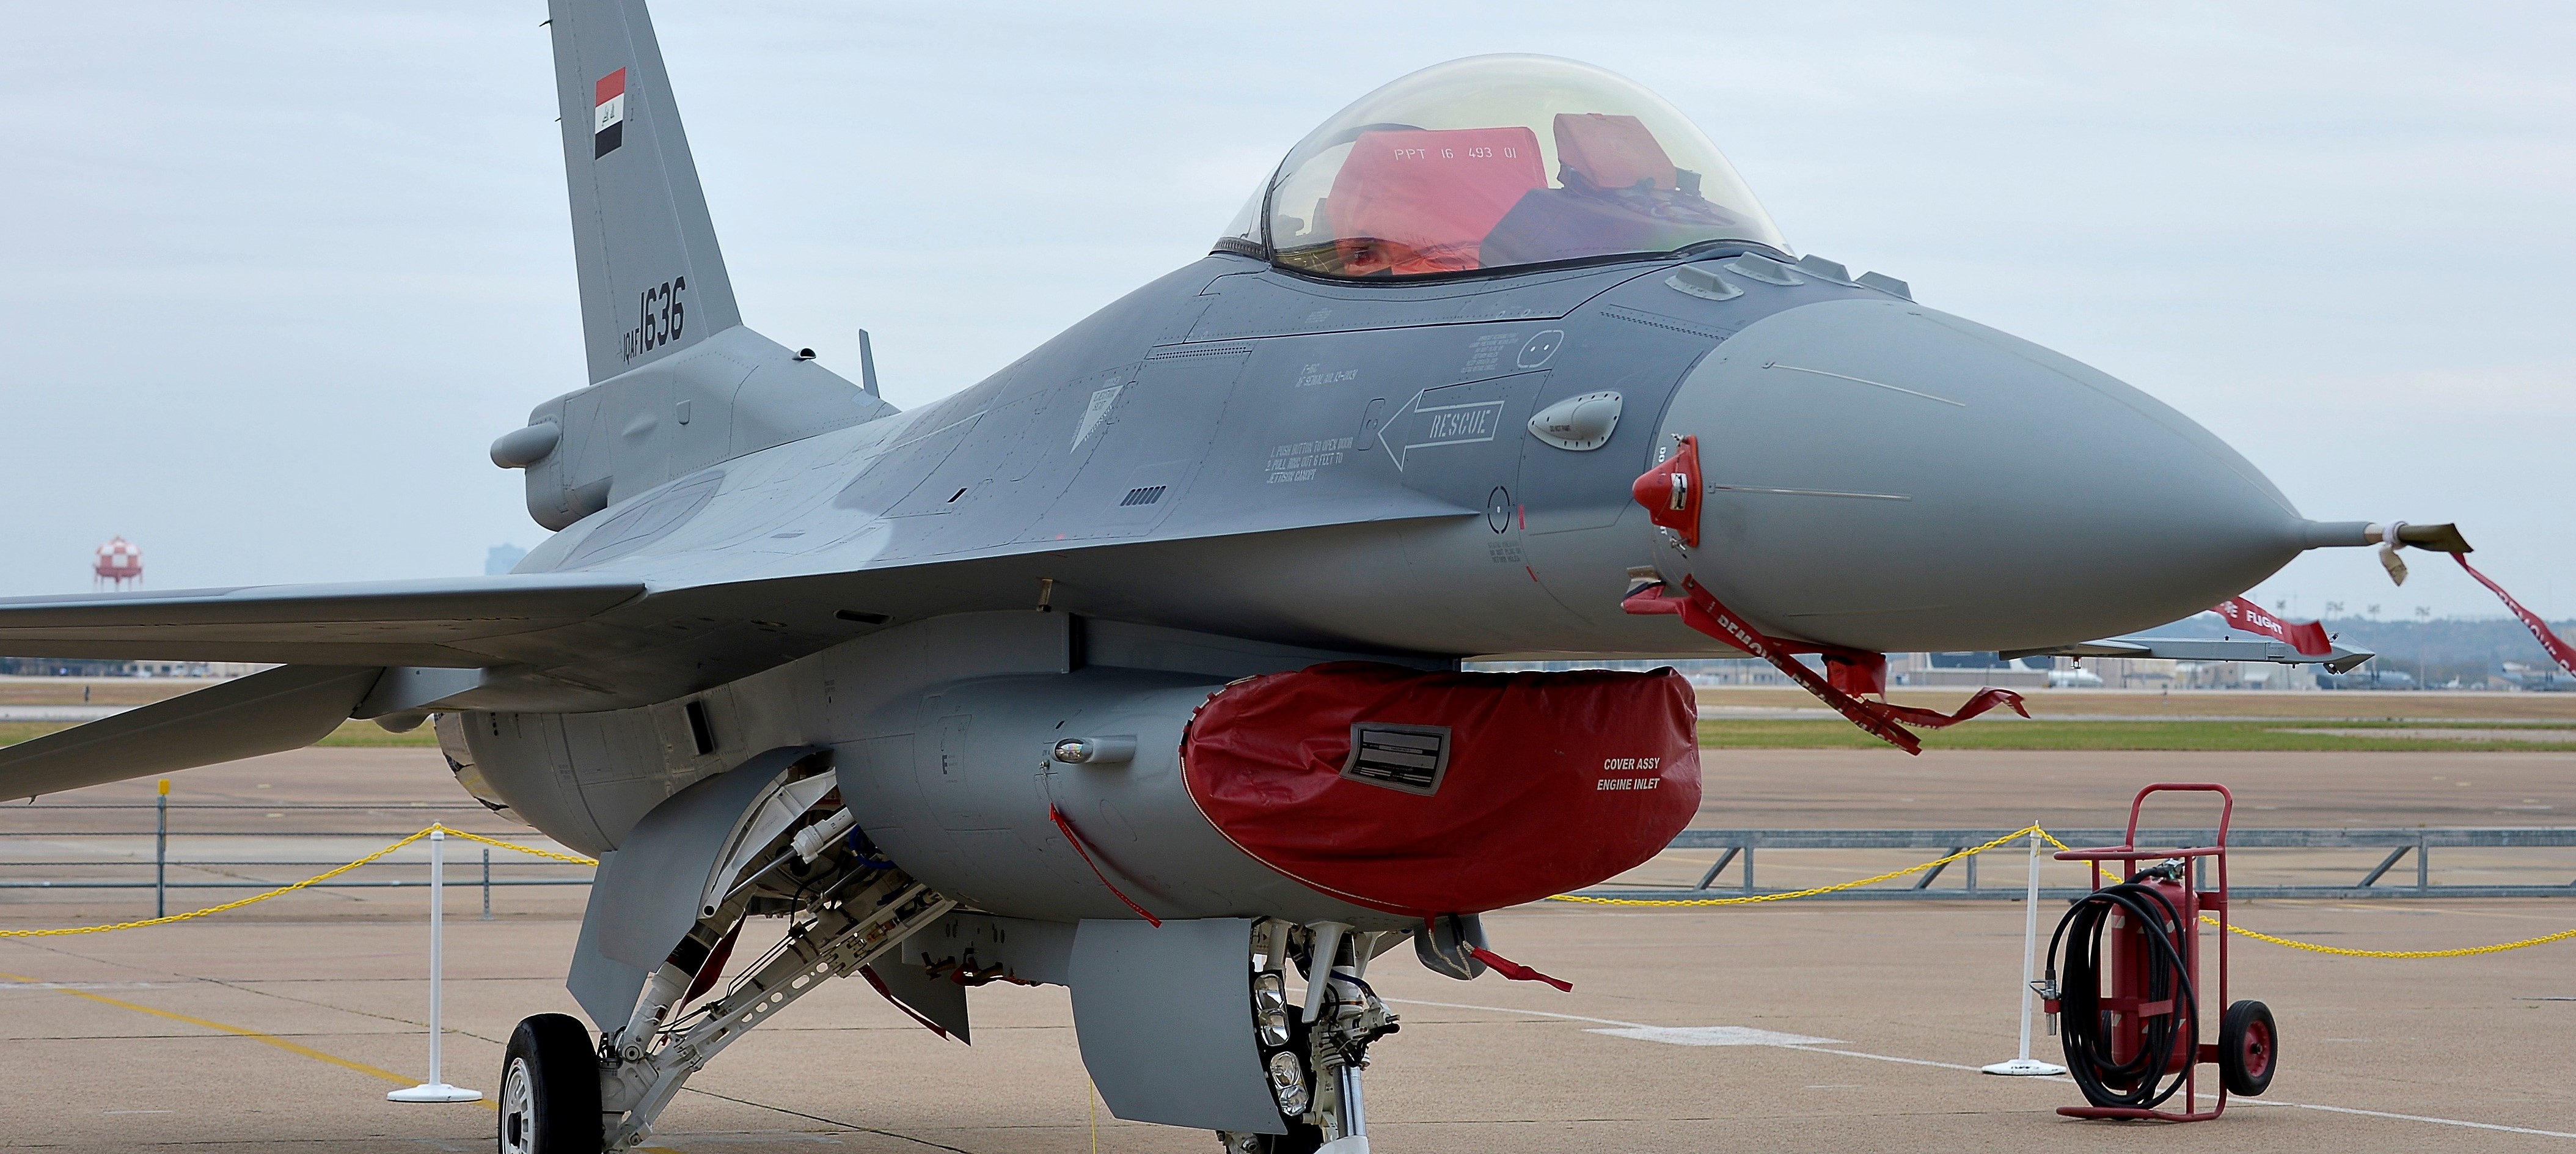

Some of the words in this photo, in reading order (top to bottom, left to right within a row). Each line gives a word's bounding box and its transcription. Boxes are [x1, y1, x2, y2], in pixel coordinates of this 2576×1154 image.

[1394, 149, 1425, 160] PPT
[1441, 148, 1454, 158] 16
[1468, 147, 1493, 158] 493
[1504, 147, 1517, 158] 01
[623, 328, 640, 366] IQAF
[640, 275, 686, 355] 1636
[1430, 410, 1491, 438] RESCUE
[1276, 444, 1292, 457] PUSH
[1291, 442, 1313, 455] BUTTON
[1314, 441, 1322, 453] TO
[1322, 439, 1337, 451] OPEN
[1272, 458, 1287, 471] PULL
[1301, 455, 1313, 466] OUT
[1319, 453, 1334, 466] FEET
[1336, 452, 1343, 464] TO
[2246, 609, 2283, 635] FLIGHT
[1604, 759, 1635, 770] COVER
[1636, 757, 1660, 770] ASSY
[1597, 779, 1633, 790] ENGINE
[1633, 777, 1660, 790] INLET
